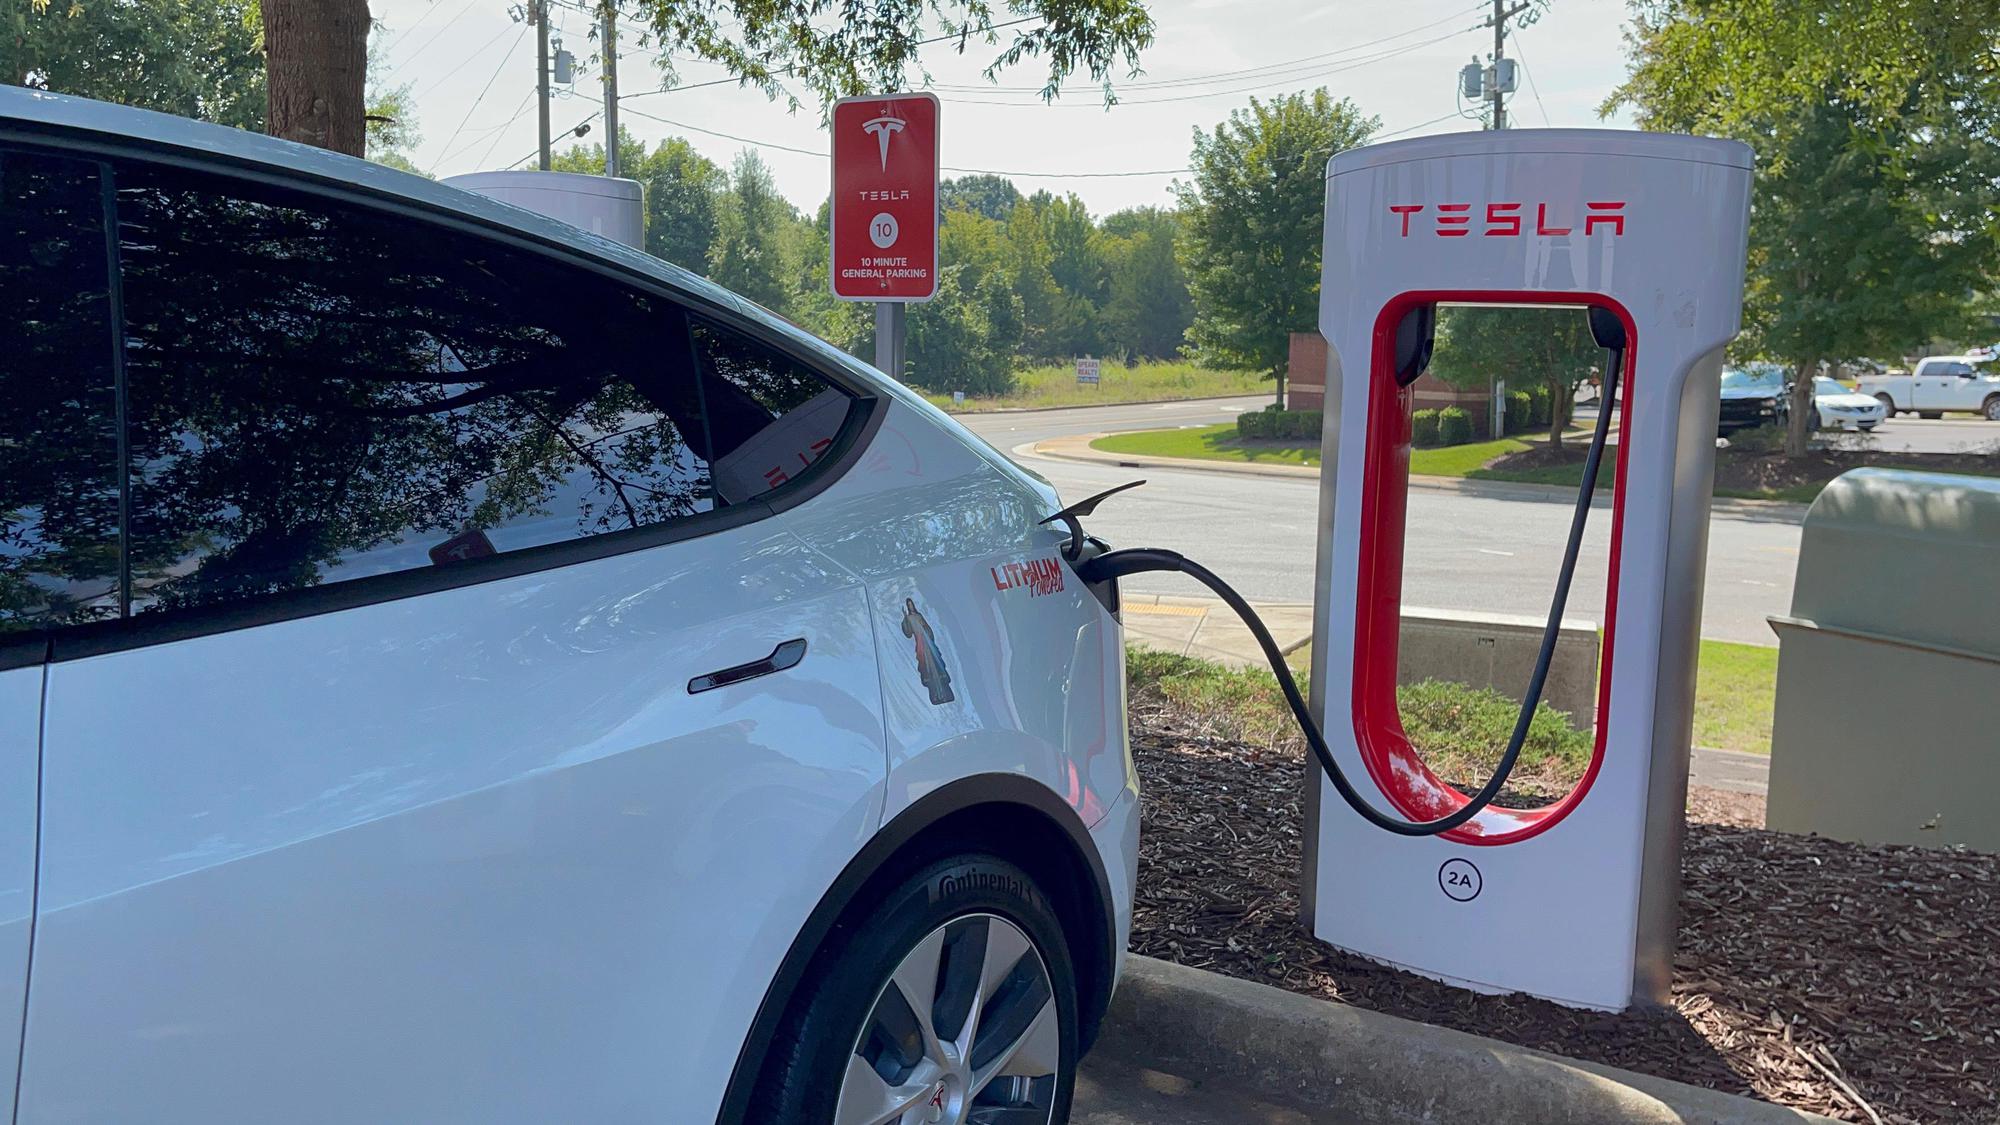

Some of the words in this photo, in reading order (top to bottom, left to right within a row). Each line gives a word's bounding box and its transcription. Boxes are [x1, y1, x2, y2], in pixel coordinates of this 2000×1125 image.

[859, 190, 909, 201] TESLA
[1389, 202, 1626, 237] TESLA
[876, 223, 892, 237] 10
[861, 257, 871, 267] 10
[873, 257, 907, 267] MINUTE
[842, 268, 884, 278] GENERAL
[886, 268, 927, 278] PARKING
[990, 557, 1063, 591] LITHIUM
[938, 867, 1023, 898] Continental
[1448, 871, 1472, 889] 2A
